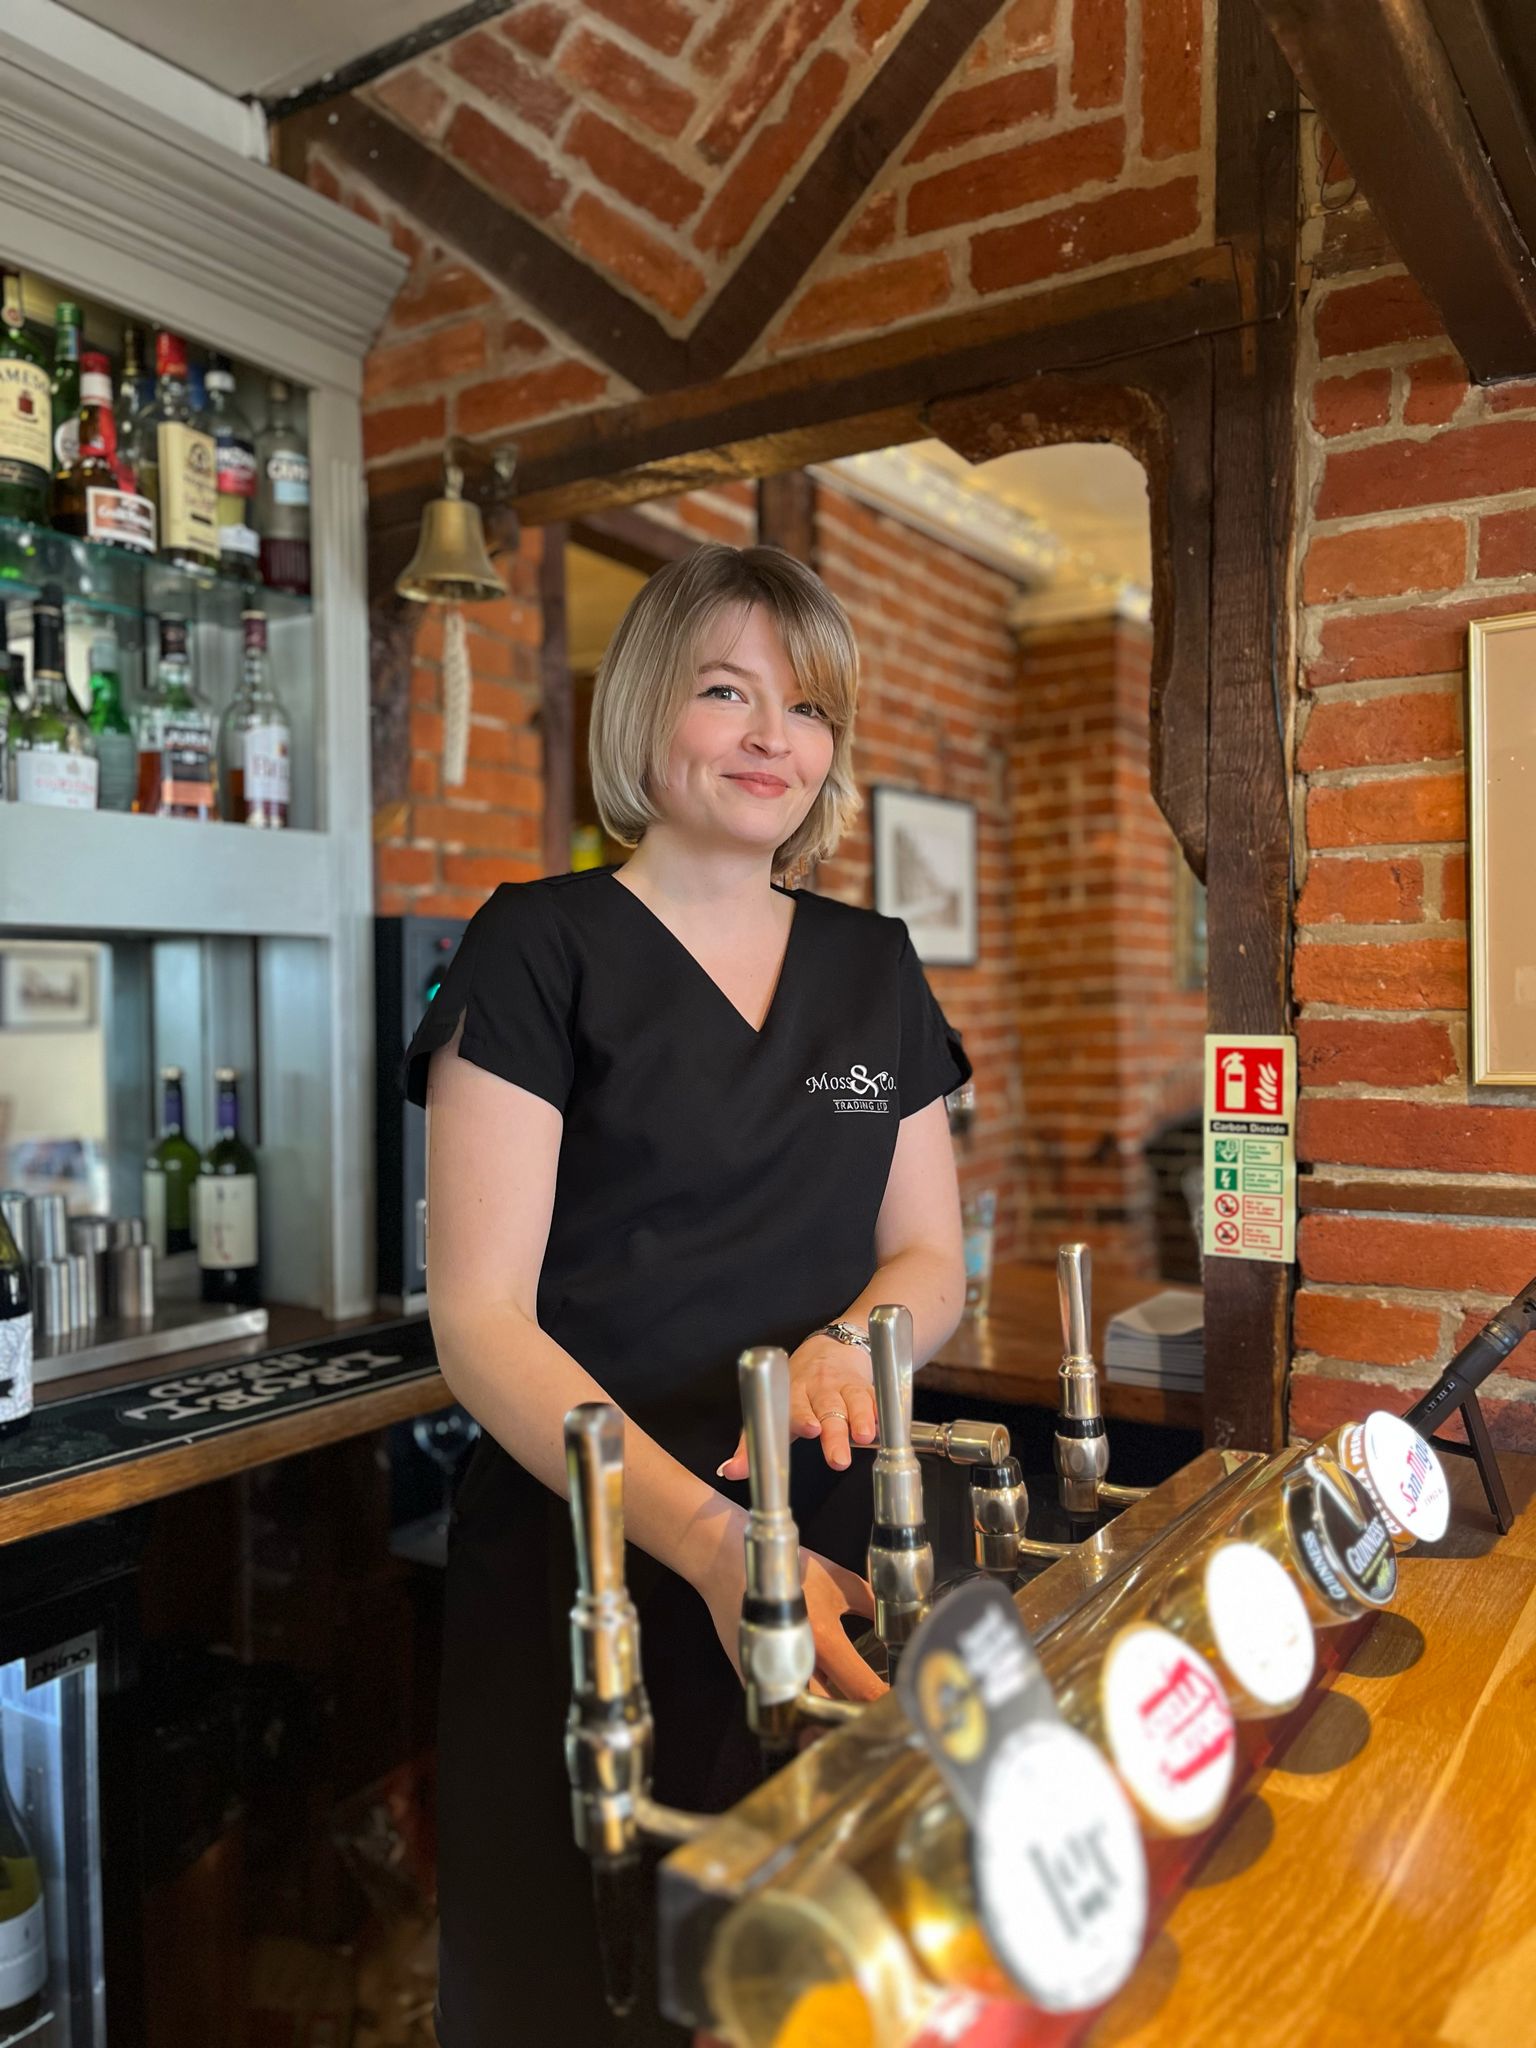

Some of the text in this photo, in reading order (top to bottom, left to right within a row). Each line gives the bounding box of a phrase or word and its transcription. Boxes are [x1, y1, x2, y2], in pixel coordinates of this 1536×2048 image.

[806, 1072, 852, 1093] Moss
[834, 1101, 888, 1111] TRADING LTD
[1212, 1121, 1286, 1134] Carbon Dioxide
[1302, 1530, 1347, 1600] GUINNESS
[32, 1647, 90, 1680] rhino
